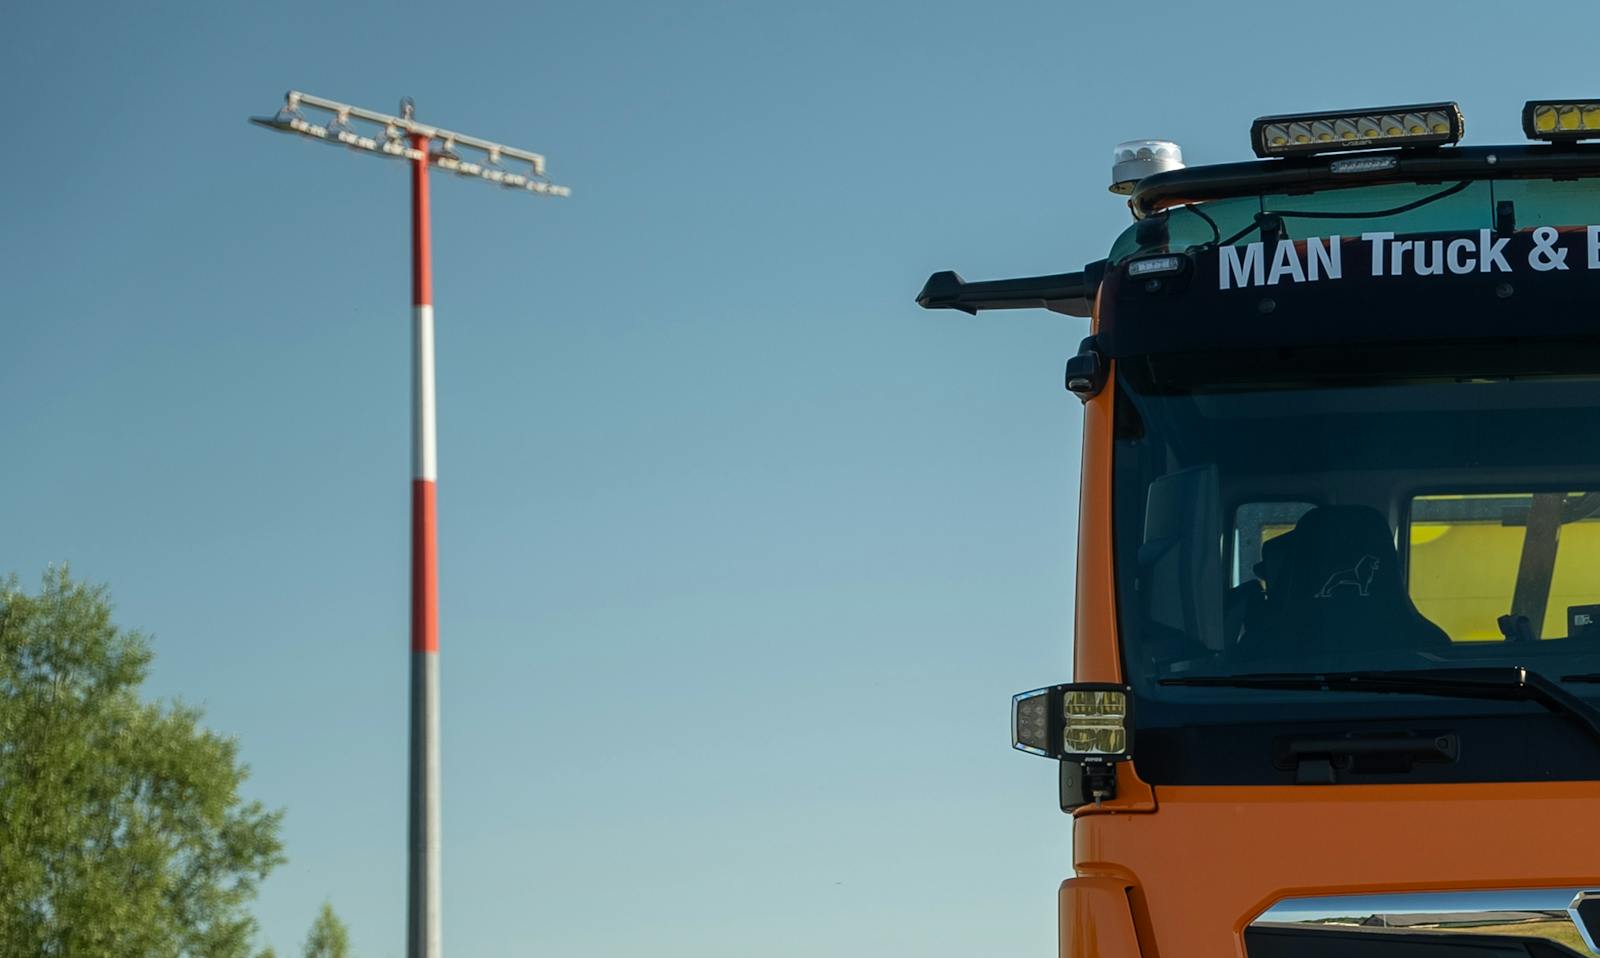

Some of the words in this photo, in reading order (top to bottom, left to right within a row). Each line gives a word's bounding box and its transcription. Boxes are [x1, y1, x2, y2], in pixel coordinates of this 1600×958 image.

[1219, 235, 1342, 290] MAN
[1362, 228, 1512, 276] Truck
[1528, 226, 1570, 272] &
